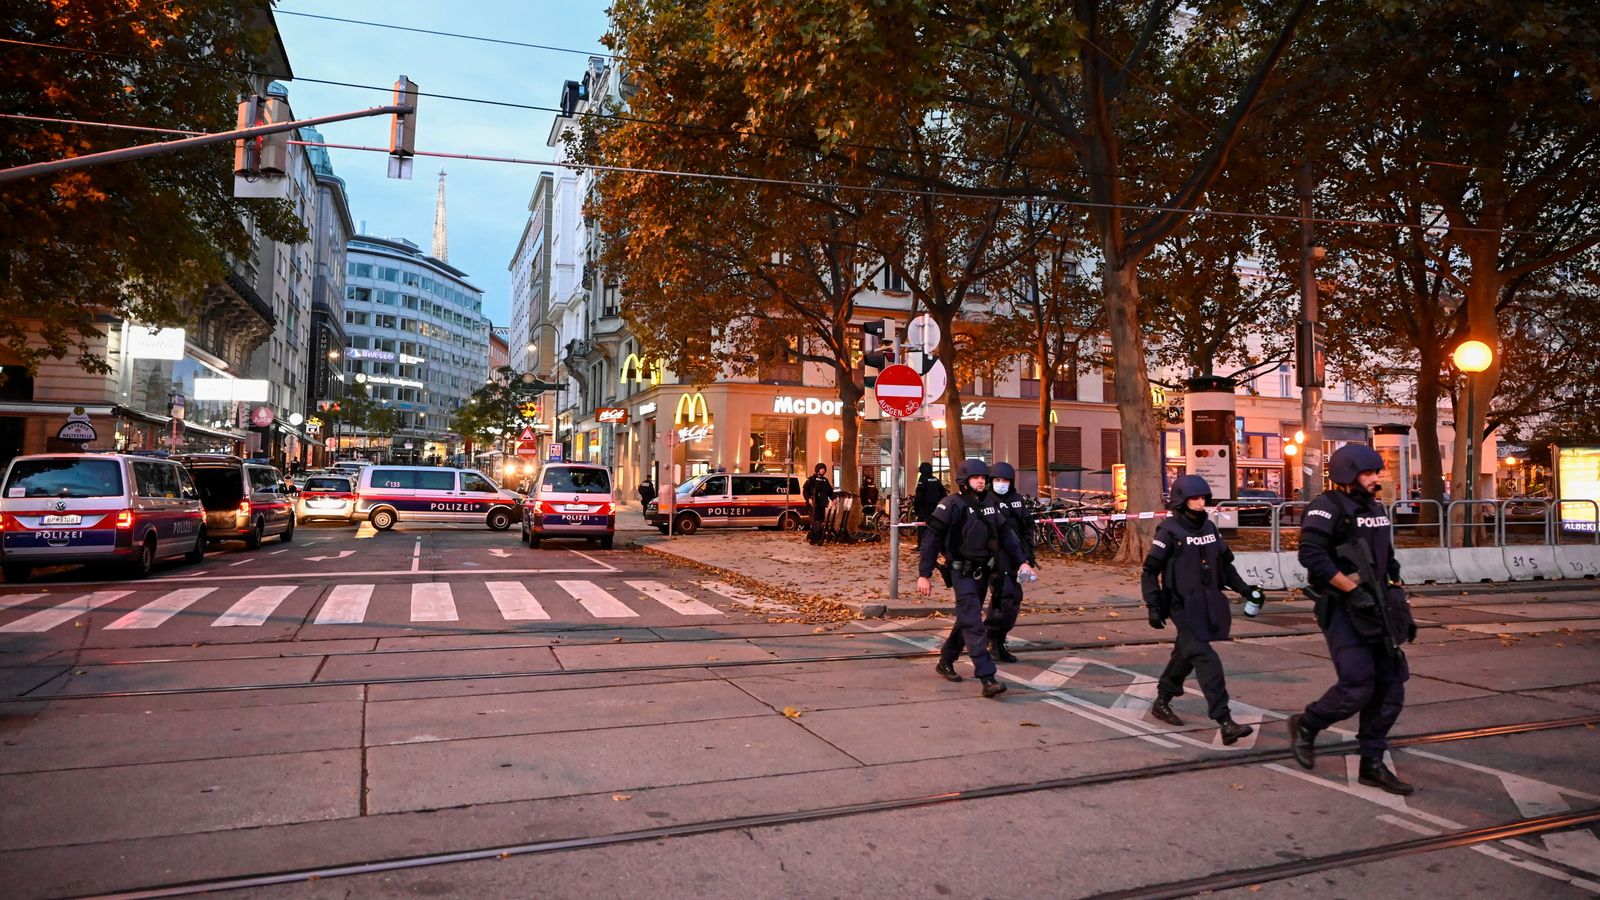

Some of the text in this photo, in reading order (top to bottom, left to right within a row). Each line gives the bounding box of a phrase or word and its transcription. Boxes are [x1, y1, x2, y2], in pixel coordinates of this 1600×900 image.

[879, 399, 904, 416] AUSGEN.
[430, 503, 473, 511] POLIZEI
[35, 531, 83, 539] POLIZEI
[1186, 533, 1217, 545] POLIZEI
